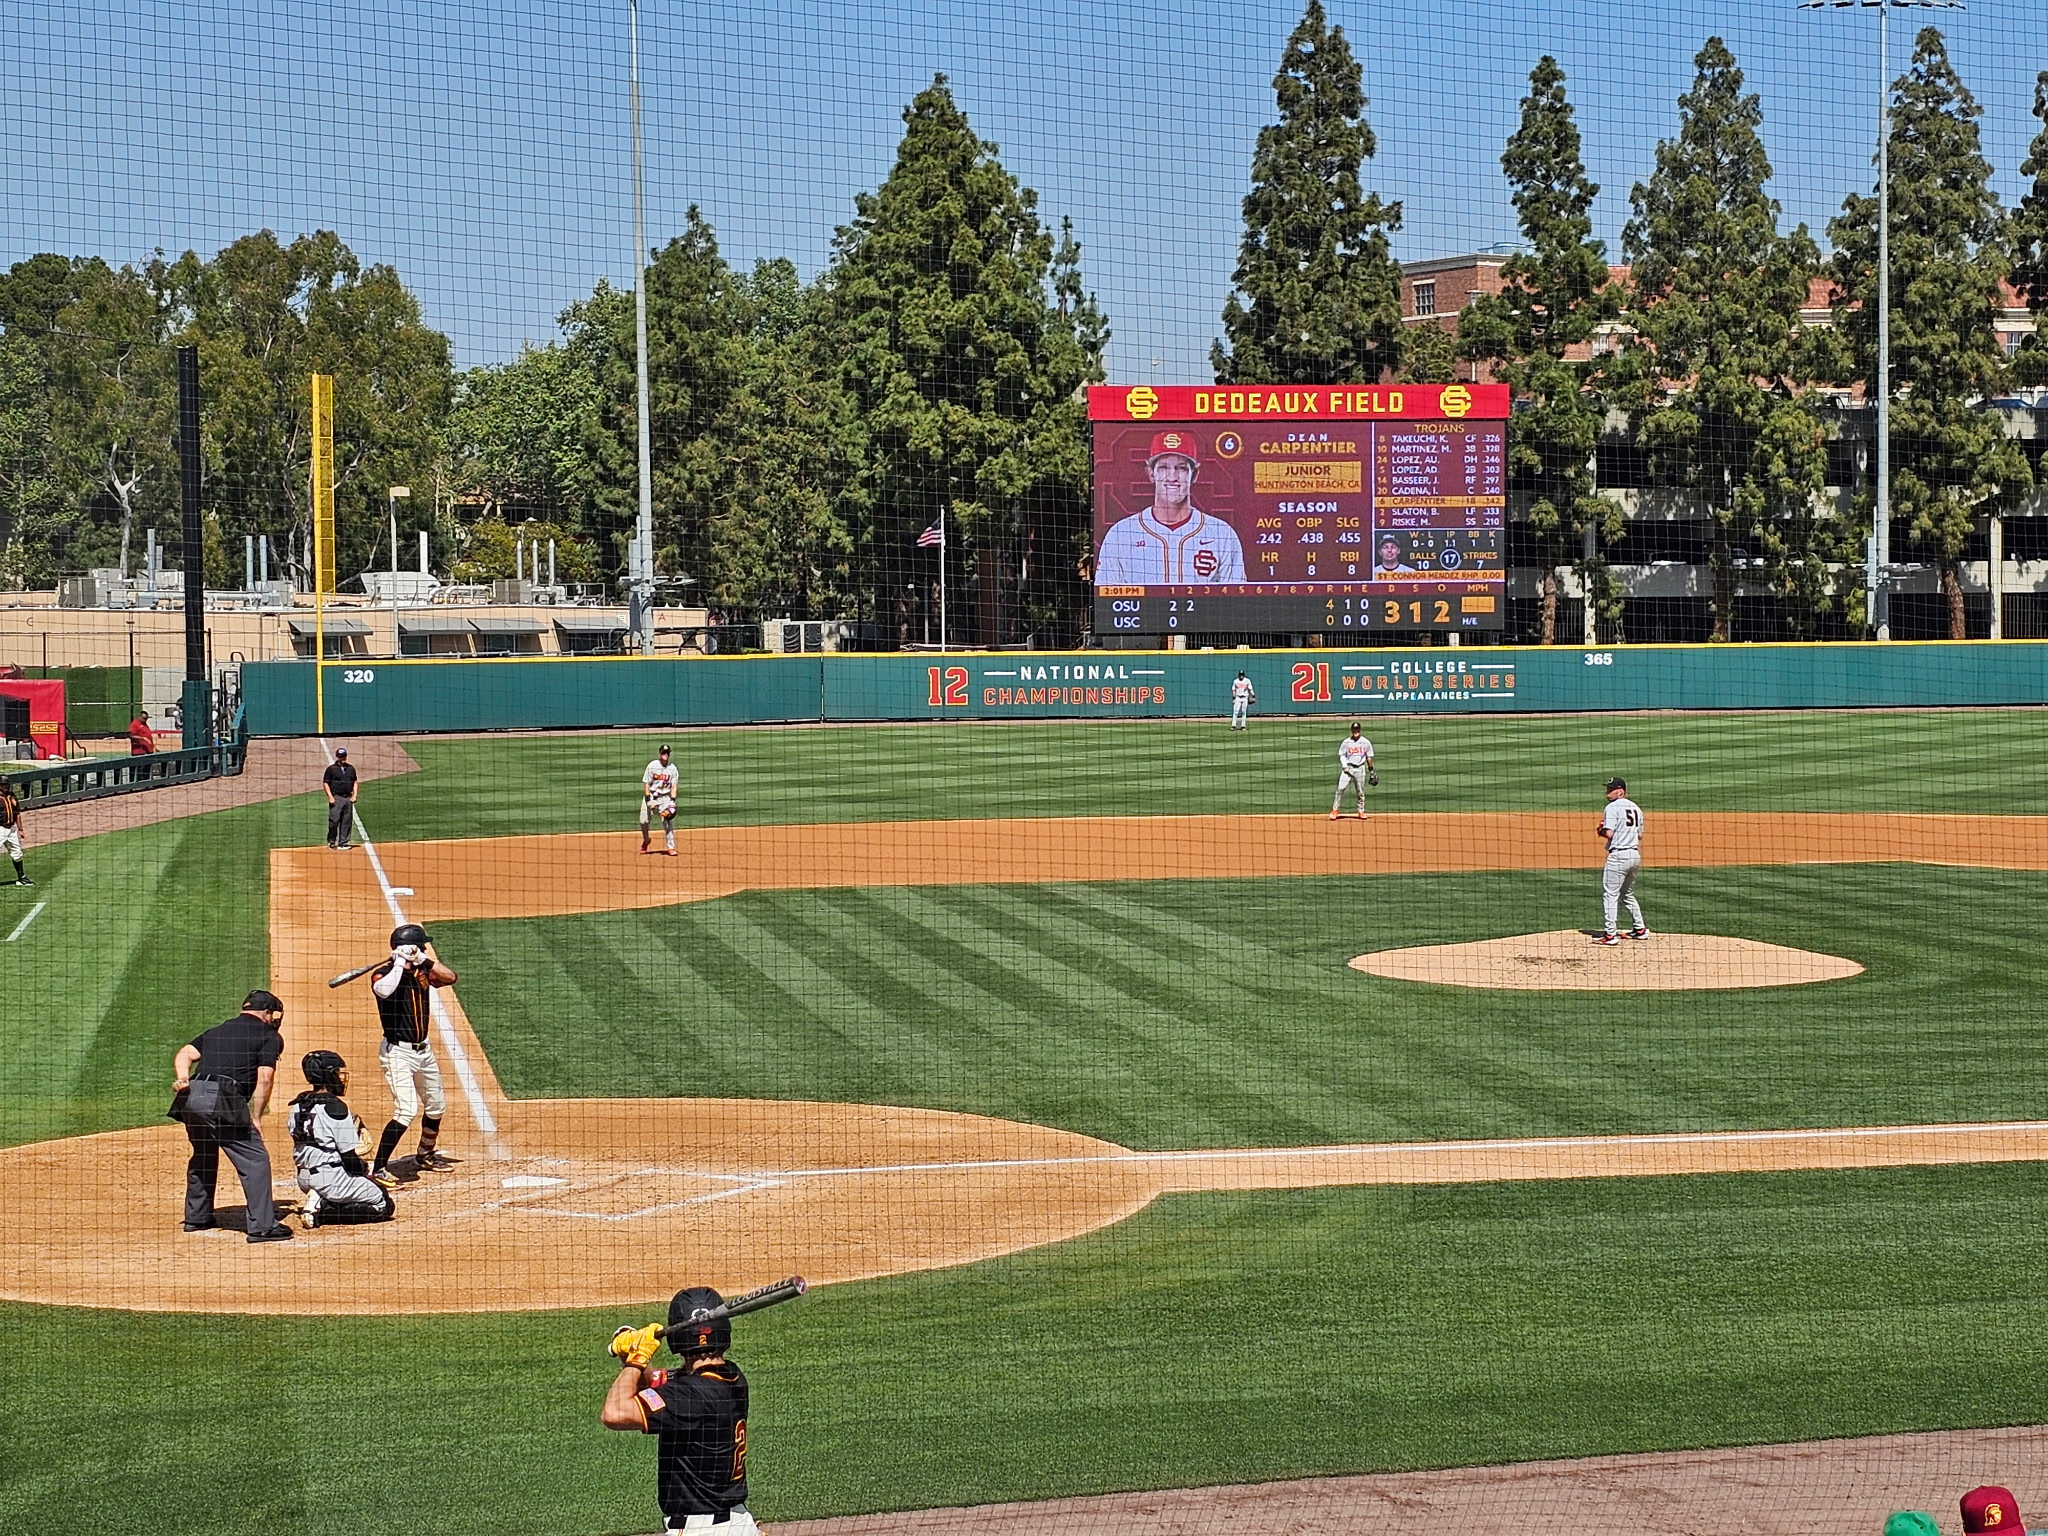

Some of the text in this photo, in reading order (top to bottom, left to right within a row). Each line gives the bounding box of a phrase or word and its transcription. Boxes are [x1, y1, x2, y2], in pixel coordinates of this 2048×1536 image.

[1195, 392, 1403, 414] DEDEAUX FIELD
[1415, 424, 1465, 433] TROJANS
[1225, 438, 1234, 449] 6
[1392, 435, 1437, 443] TAKEUCHI,
[1260, 442, 1356, 453] CARPENTIER
[1392, 456, 1422, 464] LOPEZ,
[1286, 466, 1331, 475] JUNIOR
[1255, 481, 1313, 489] HUNTINGTON
[1316, 481, 1345, 489] BEACH,
[1393, 477, 1431, 485] BASSEER,
[1483, 476, 1499, 484] .297
[1392, 487, 1430, 495] CADENA,
[1279, 502, 1337, 512] SEASON
[1392, 508, 1428, 516] SLATON,
[1256, 518, 1359, 527] AVG OBP SLG
[1256, 533, 1360, 544] .242 .438 .455
[1262, 552, 1359, 562] HR H RBI
[1444, 554, 1455, 563] 17
[1269, 564, 1355, 576] 1 8 8
[1417, 561, 1429, 569] 10
[1477, 560, 1483, 569] 7
[1327, 585, 1333, 593] R
[1344, 585, 1351, 593] H
[1438, 584, 1446, 592] O
[1468, 584, 1488, 592] MPH
[1113, 600, 1368, 611] OSU 2 2 4 1 0
[1385, 601, 1450, 623] 3 1 2
[1114, 615, 1368, 628] USC 0 0 0 0
[1584, 653, 1613, 665] 365
[1020, 665, 1129, 680] NATIONAL
[1391, 661, 1466, 674] COLLEGE
[344, 670, 374, 683] 320
[1291, 662, 1332, 702] 21
[1342, 674, 1515, 690] WORLD SERIES
[928, 666, 969, 705] 12
[984, 686, 1165, 705] CHAMPIONSHIPS
[1387, 691, 1470, 701] APPEARANCES
[1625, 809, 1639, 828] 51
[731, 1280, 791, 1307] LOUISVILLE
[699, 1335, 707, 1346] 2
[731, 1418, 748, 1481] 2
